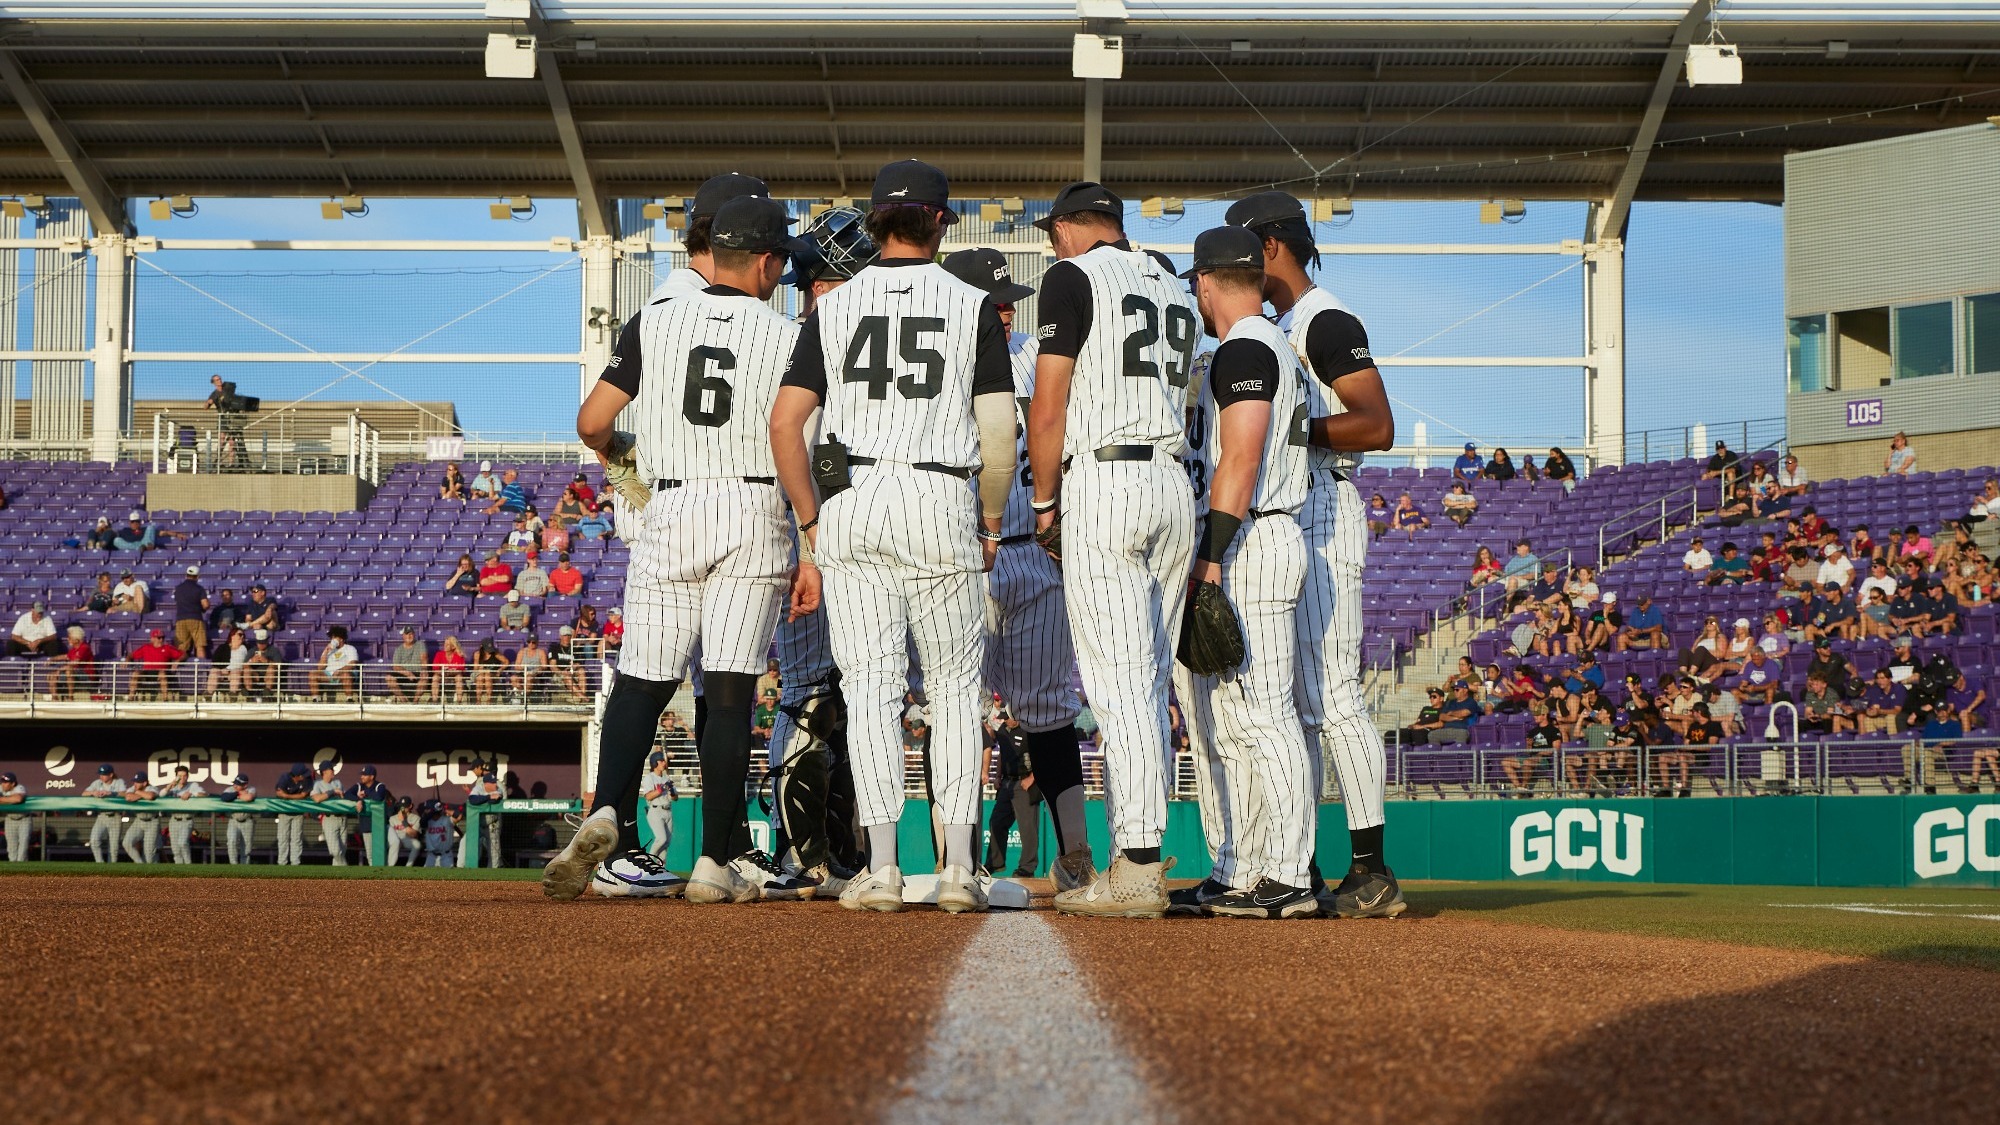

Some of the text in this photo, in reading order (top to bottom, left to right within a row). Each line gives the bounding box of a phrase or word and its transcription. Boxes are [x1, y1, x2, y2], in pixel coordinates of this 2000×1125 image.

[842, 315, 946, 400] 45
[1121, 293, 1197, 389] 29
[682, 344, 737, 428] 6
[1231, 379, 1263, 393] WAC
[1848, 402, 1881, 425] 105
[429, 439, 462, 458] 107
[45, 778, 74, 790] pepsi
[147, 746, 240, 787] GCU
[1509, 807, 1645, 877] GCU
